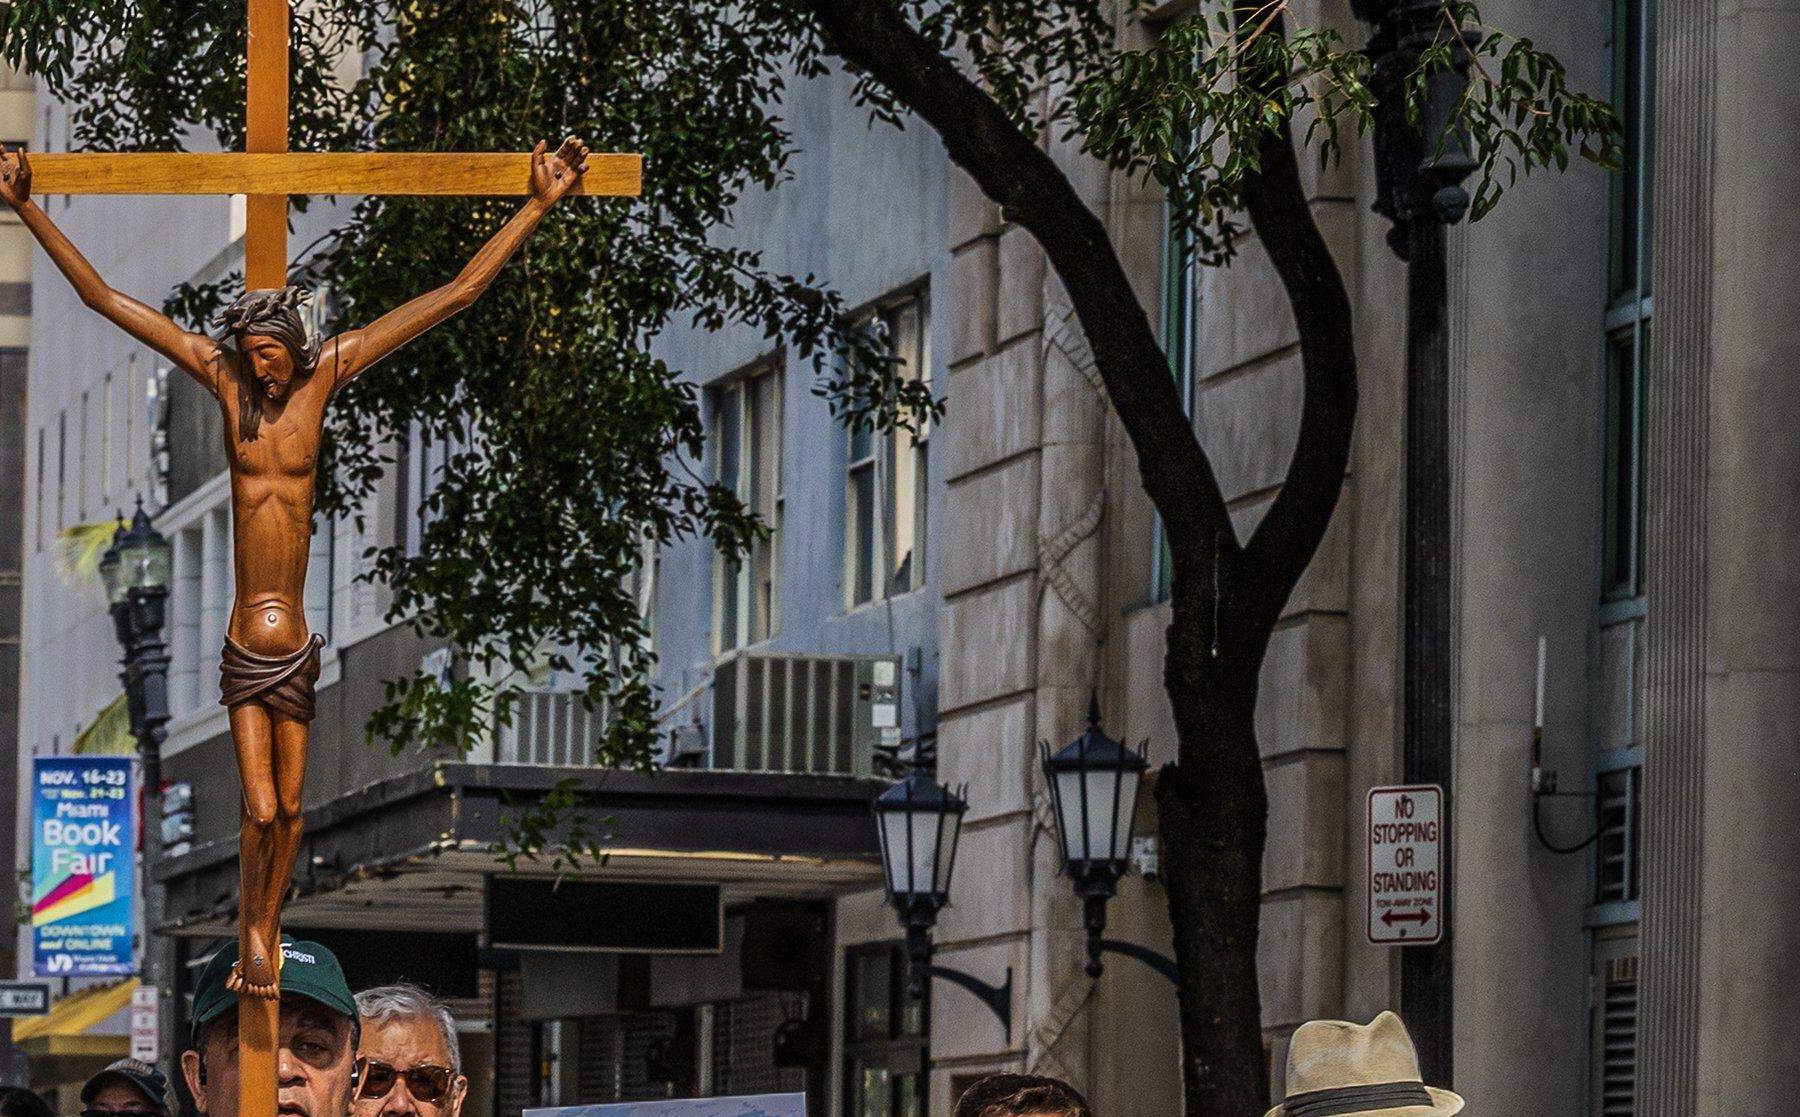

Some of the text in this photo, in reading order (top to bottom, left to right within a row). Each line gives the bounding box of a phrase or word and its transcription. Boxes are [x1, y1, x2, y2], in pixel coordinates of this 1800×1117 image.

[40, 769, 78, 785] NOV.
[56, 801, 109, 818] Miami
[1395, 798, 1415, 819] NO
[43, 819, 121, 846] Book
[1373, 821, 1437, 845] STOPPING
[51, 848, 114, 875] Fair
[1395, 847, 1415, 869] OR
[1373, 871, 1437, 894] STANDING
